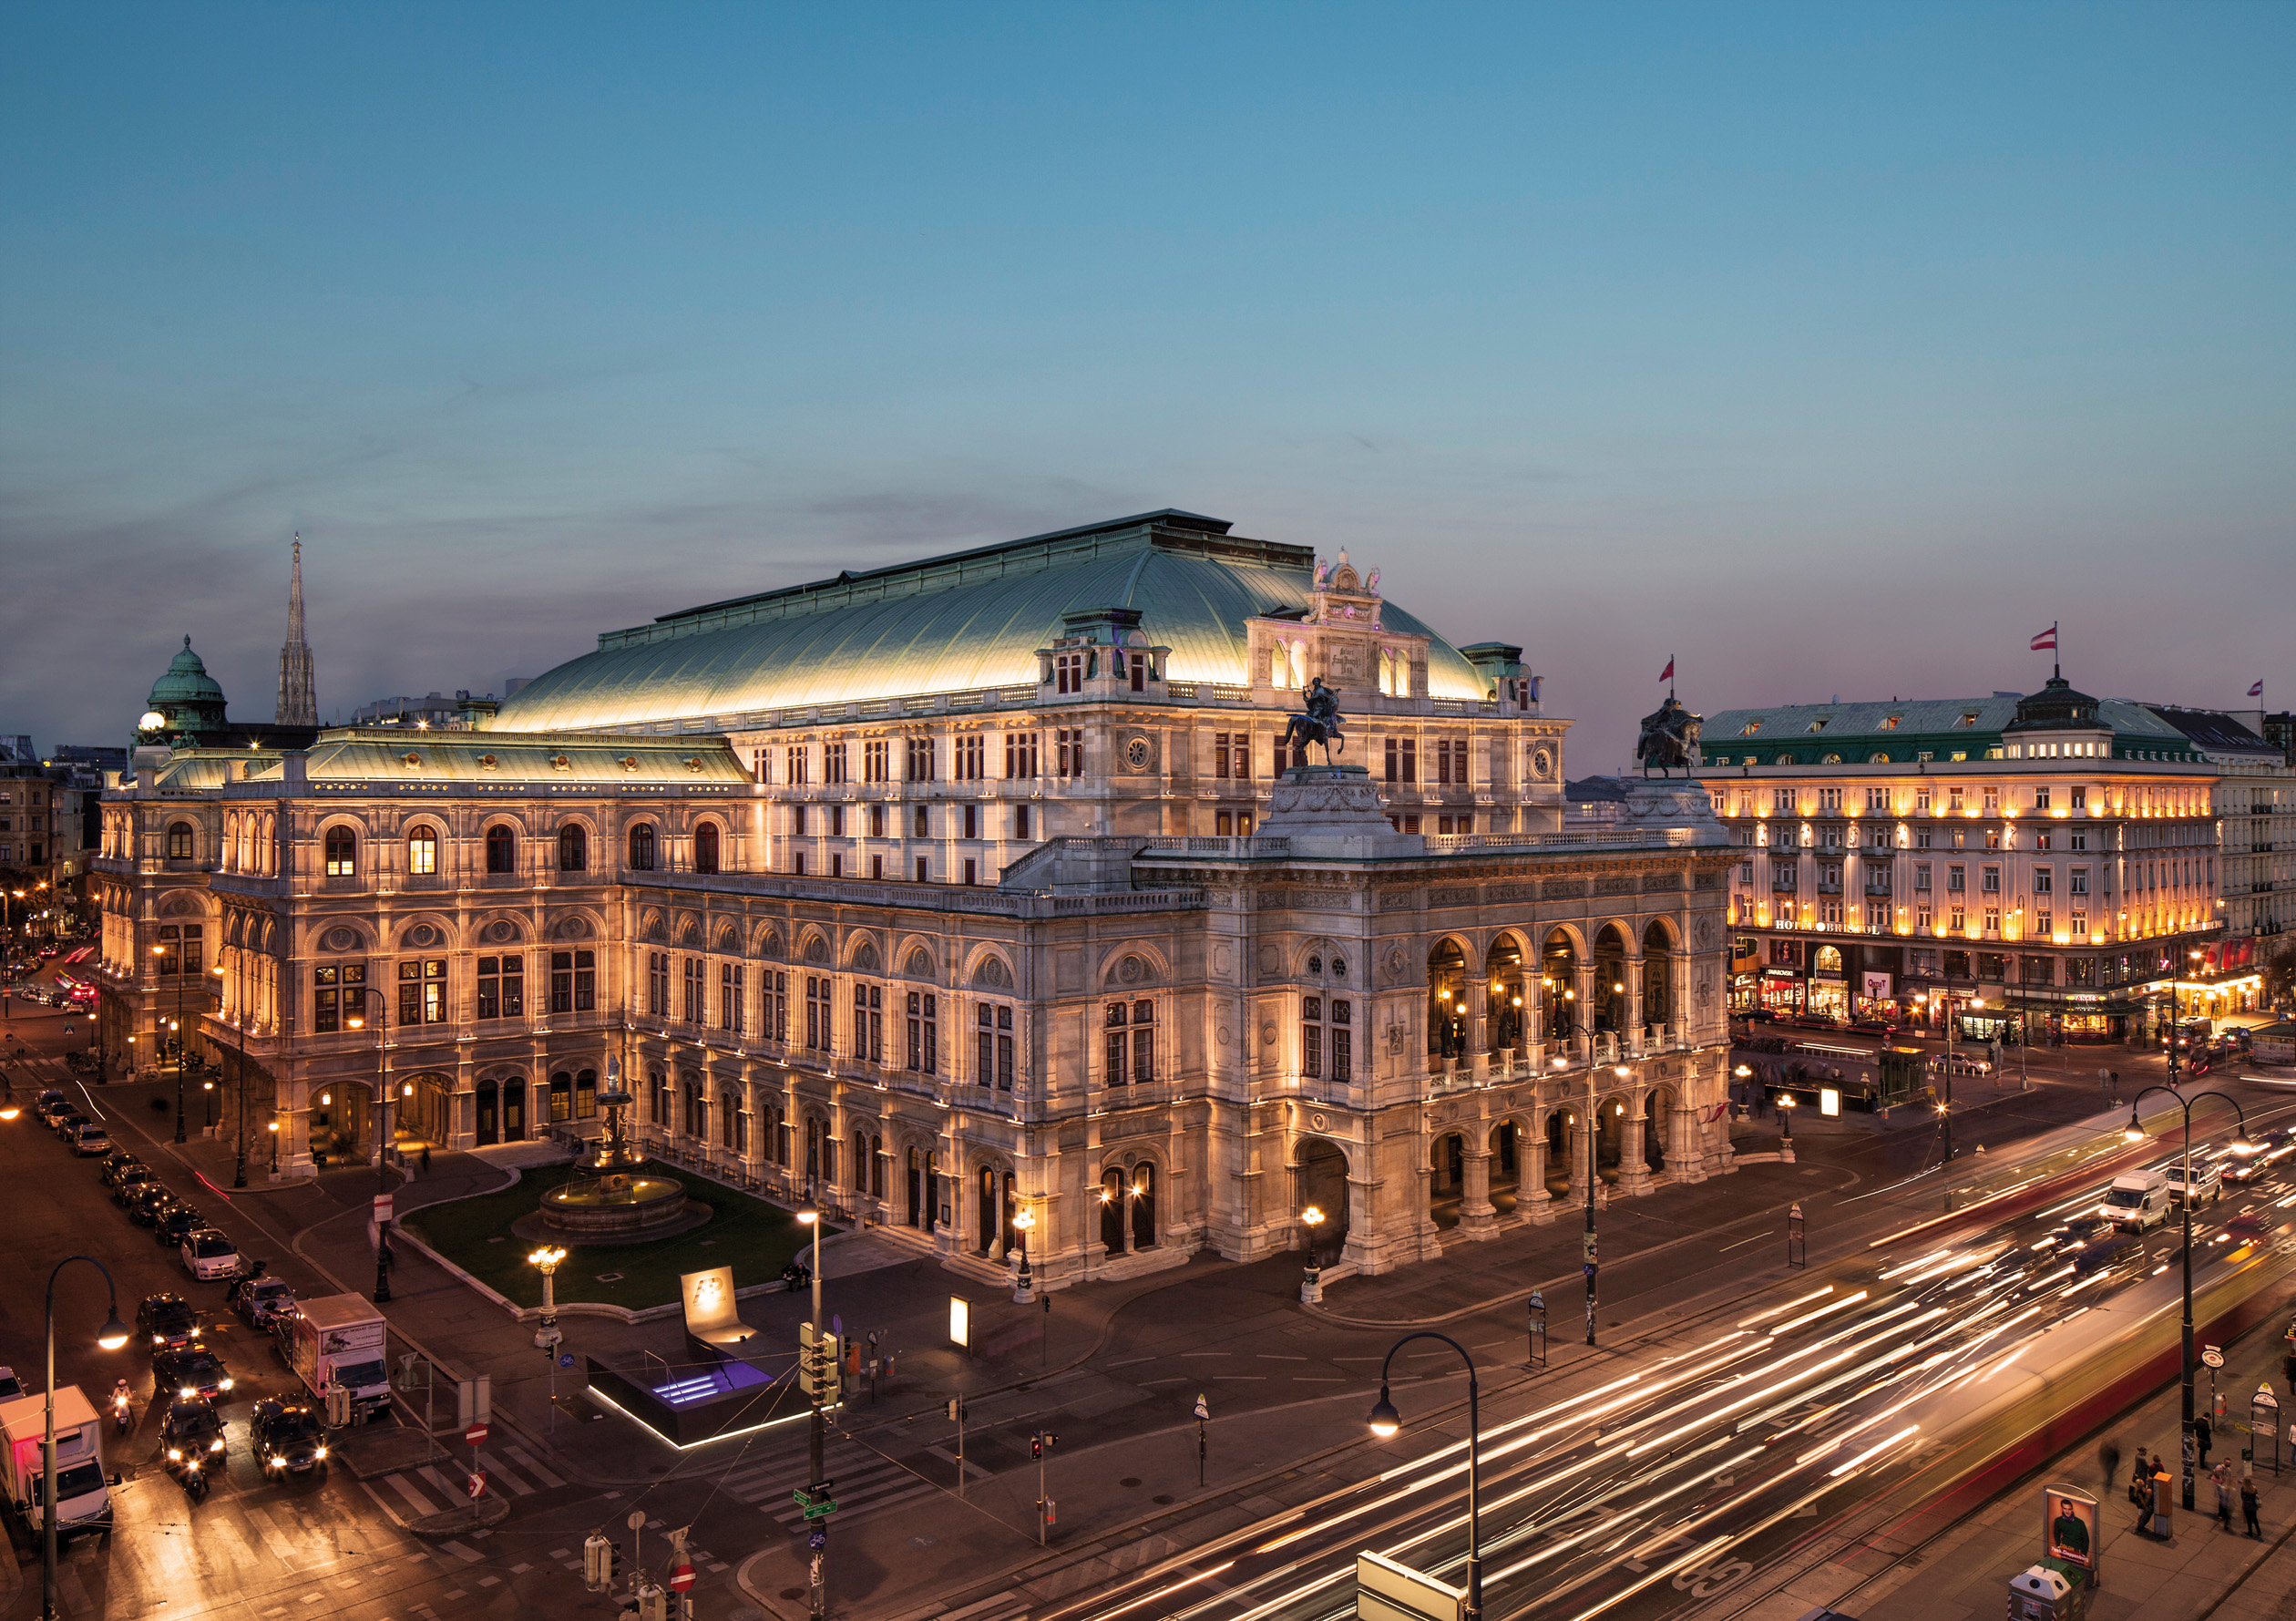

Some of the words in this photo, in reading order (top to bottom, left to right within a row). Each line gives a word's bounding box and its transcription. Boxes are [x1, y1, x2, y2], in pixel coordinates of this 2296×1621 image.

[1776, 919, 1815, 931] HOTEL
[1826, 922, 1881, 935] BRISTOL
[1768, 969, 1794, 977] SWAROVSKI
